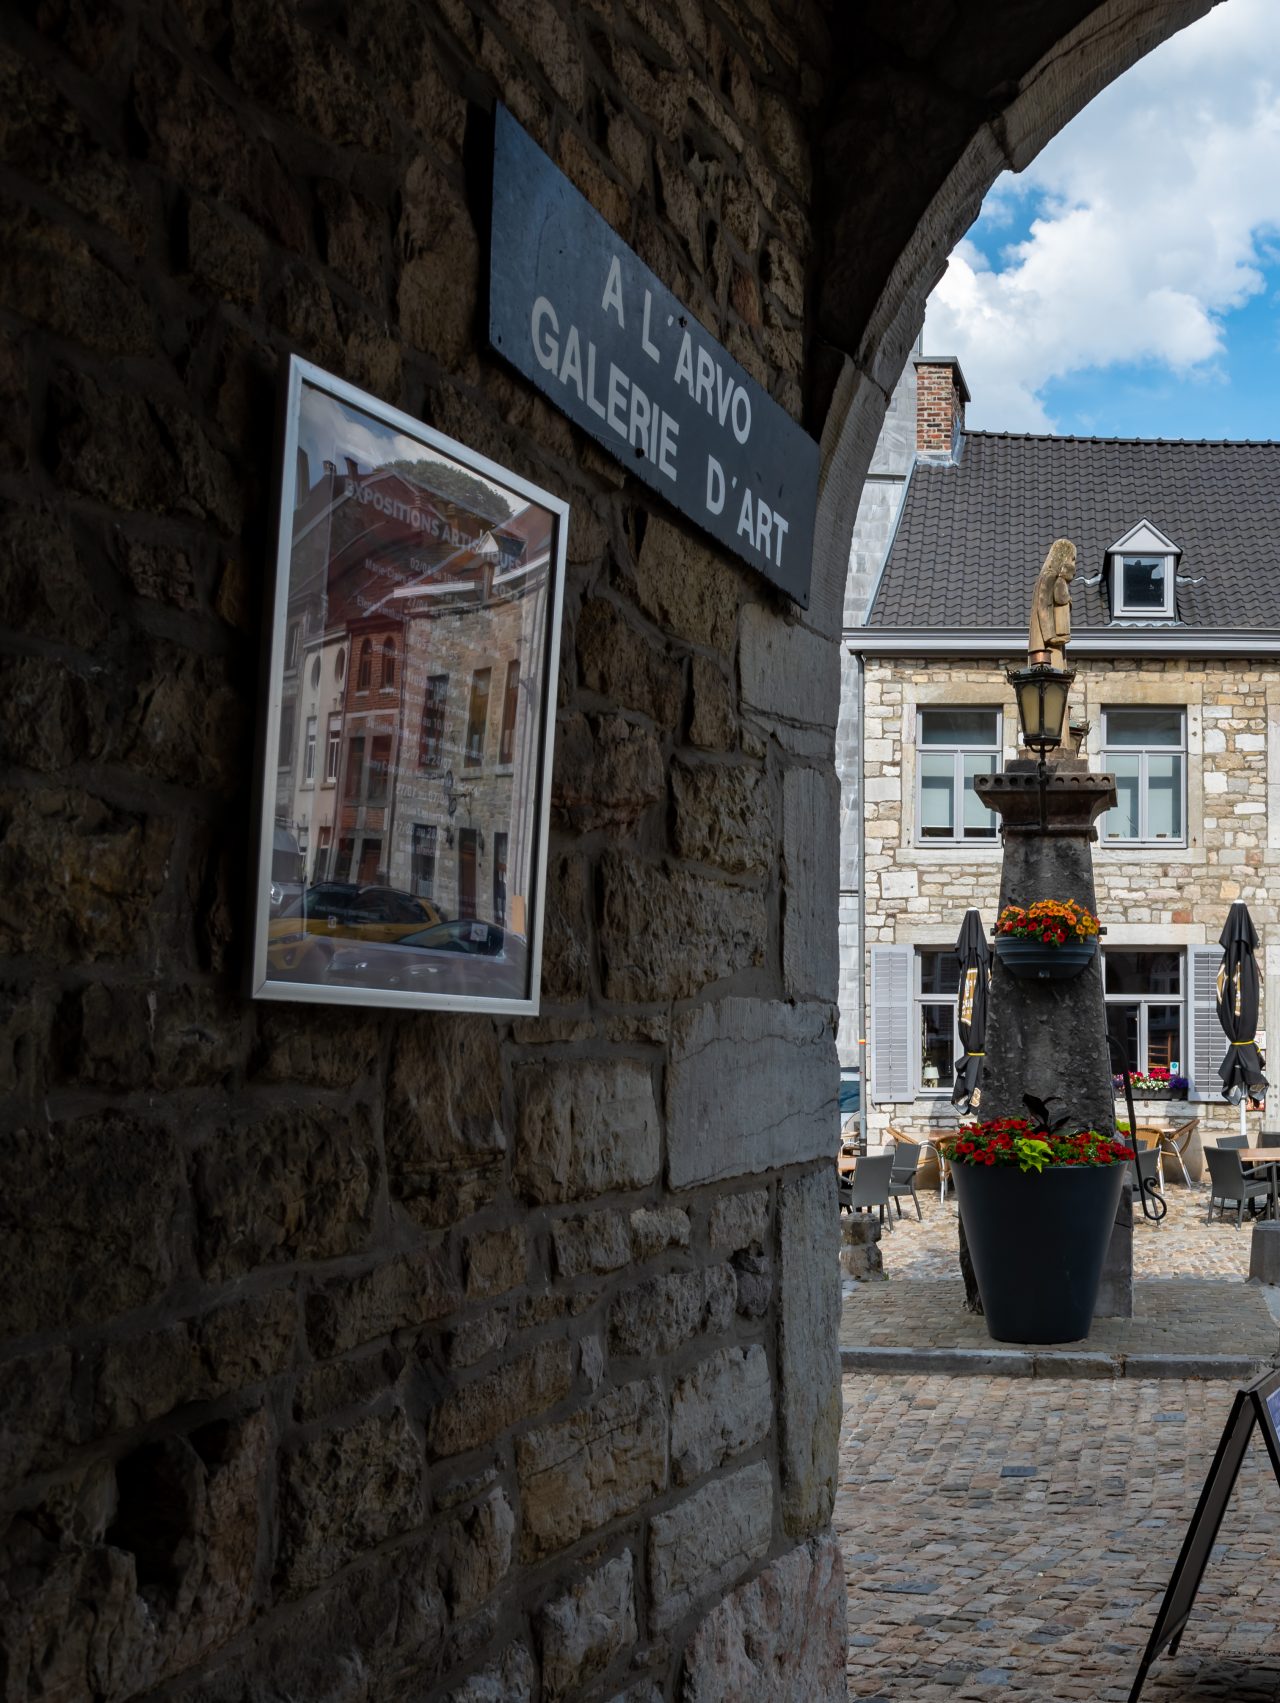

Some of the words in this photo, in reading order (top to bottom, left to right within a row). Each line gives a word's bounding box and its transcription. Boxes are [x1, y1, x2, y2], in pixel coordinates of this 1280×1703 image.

[600, 254, 626, 329] A
[530, 295, 681, 482] GALERIE
[704, 453, 789, 568] D'ART
[343, 477, 439, 538] EXPOSITIONS
